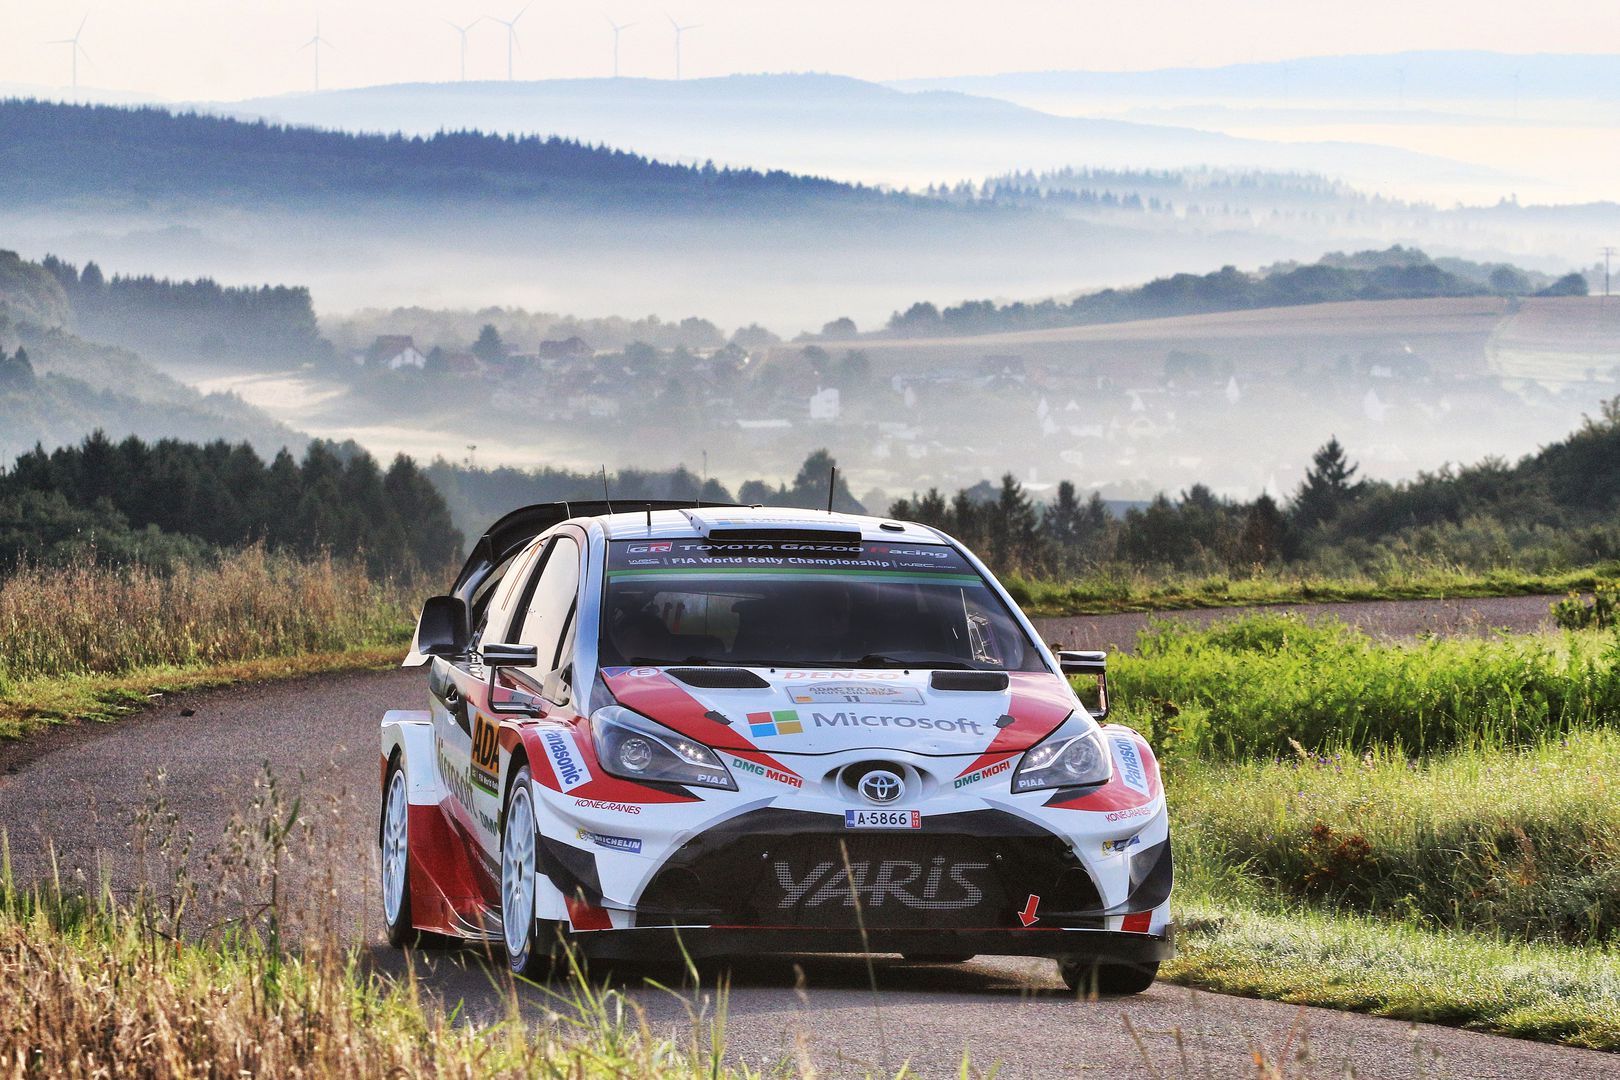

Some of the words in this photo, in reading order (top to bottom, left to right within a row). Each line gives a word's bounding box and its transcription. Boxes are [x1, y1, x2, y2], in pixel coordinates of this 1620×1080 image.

[781, 544, 865, 552] GAZOO
[869, 547, 948, 559] Racing
[748, 557, 784, 565] Rally
[788, 557, 890, 568] Championship
[784, 671, 899, 680] DENSO
[812, 712, 984, 736] Microsoft
[697, 774, 728, 785] PIAA
[732, 758, 765, 776] DMG
[765, 769, 803, 788] MORI
[954, 772, 981, 789] DMG
[981, 760, 1011, 779] MORI
[1018, 777, 1045, 788] PIAA
[574, 799, 642, 815] KONECRANES
[1104, 807, 1152, 823] KONECRANES
[594, 835, 641, 849] MICHELIN
